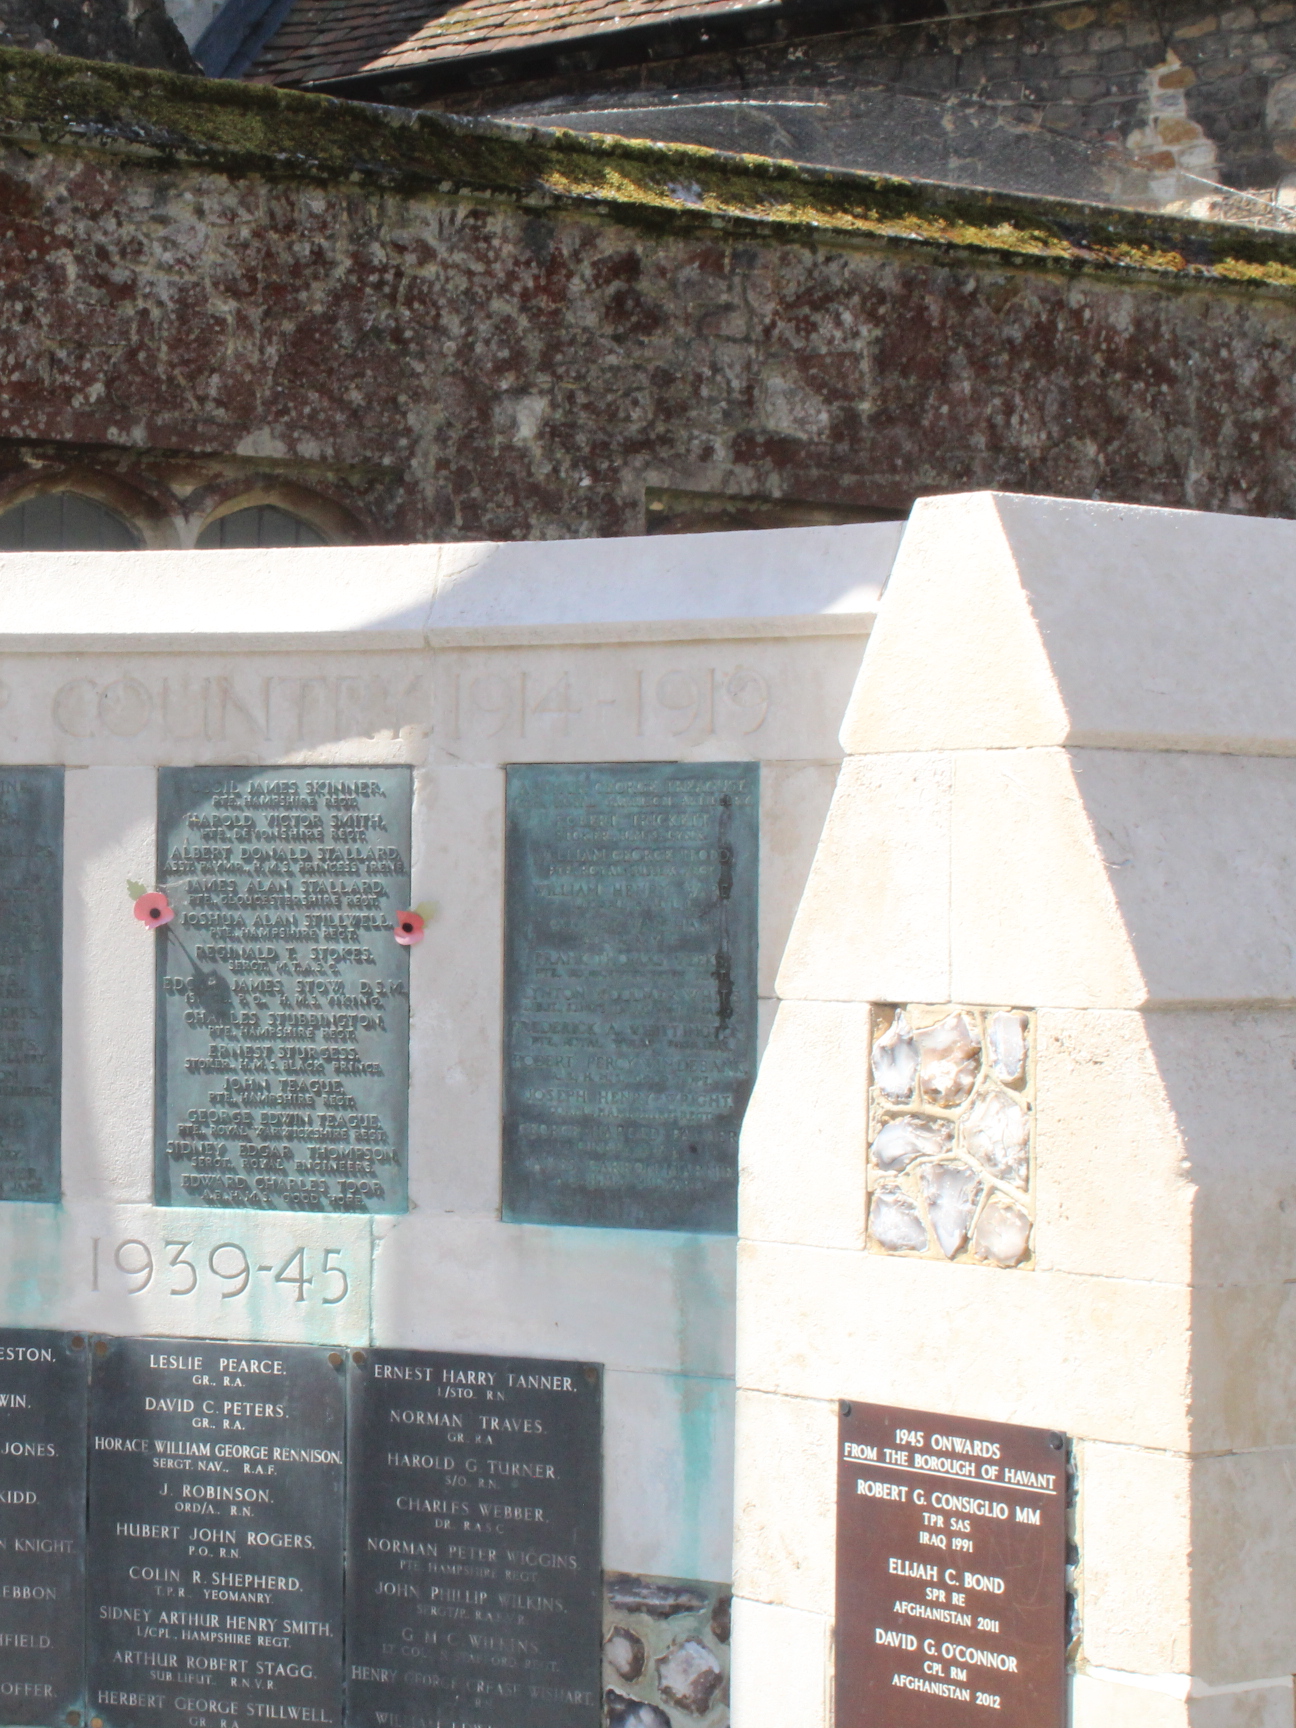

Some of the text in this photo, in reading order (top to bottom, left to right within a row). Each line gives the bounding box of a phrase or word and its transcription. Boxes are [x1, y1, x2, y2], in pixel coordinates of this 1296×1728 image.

[50, 677, 426, 742] COUNTRY
[247, 782, 298, 793] JAMES
[244, 796, 357, 808] HAMPSHIRE REGT.
[187, 814, 253, 826] HAROLD
[265, 814, 321, 827] VICTOR
[172, 847, 232, 859] ALBERT
[241, 847, 309, 859] DONALD
[186, 880, 235, 892] JAMES
[246, 881, 289, 892] ALAN
[181, 913, 244, 925] JOSHUA
[254, 914, 300, 926] ALAN
[196, 946, 276, 958] REGINALD
[209, 1046, 271, 1058] ERNEST
[223, 1079, 269, 1090] JOHN
[188, 1111, 252, 1123] GEORGE
[260, 1112, 310, 1125] EDWIN
[242, 1159, 283, 1169] ROYAL
[182, 1175, 327, 1192] EDWARD CHARLES
[91, 1237, 349, 1304] 1939-45
[151, 1355, 202, 1370] LESLIE
[224, 1376, 245, 1387] R.A.
[375, 1364, 432, 1381] ERNEST
[443, 1370, 496, 1385] HARRY
[146, 1398, 194, 1412] DAVID
[203, 1401, 219, 1413] C.
[223, 1419, 245, 1430] R.A.
[391, 1410, 462, 1427] NORMAN
[96, 1437, 147, 1451] HORACE
[155, 1441, 210, 1456] WILLIAM
[215, 1444, 268, 1459] GEORGE
[896, 1429, 1000, 1459] 1945 ONWARDS
[153, 1458, 193, 1469] SERGT.
[244, 1463, 277, 1474] R.A.F.
[388, 1453, 454, 1470] HAROLD
[845, 1442, 1056, 1489] FROM THE BOROUGH OF HAVANT
[159, 1483, 173, 1496] J.
[857, 1479, 1040, 1525] ROBERT G. CONSIGLIO MM
[231, 1506, 254, 1516] R.N.
[923, 1513, 970, 1532] TPR SAS
[117, 1523, 179, 1539] HUBERT
[190, 1528, 235, 1543] JOHN
[920, 1531, 973, 1552] IRAQ 1991
[220, 1548, 241, 1558] R.N.
[129, 1567, 179, 1581] COLIN
[193, 1571, 207, 1583] R.
[889, 1558, 1004, 1594] ELIJAH C. BOND
[926, 1588, 965, 1606] SPR RE
[100, 1606, 151, 1622] SIDNEY
[159, 1612, 219, 1627] ARTHUR
[227, 1616, 277, 1631] HENRY
[894, 1601, 999, 1633] AFGHANISTAN 2011
[182, 1630, 292, 1647] HAMPSHIRE REGT.
[876, 1628, 1017, 1673] DAVID G. O'CONNOR
[113, 1651, 177, 1667] ARTHUR
[187, 1656, 248, 1672] ROBERT
[924, 1661, 966, 1681] CPL RM
[892, 1674, 1000, 1708] AFGHANISTAN 2012
[175, 1697, 237, 1714] GEORGE
